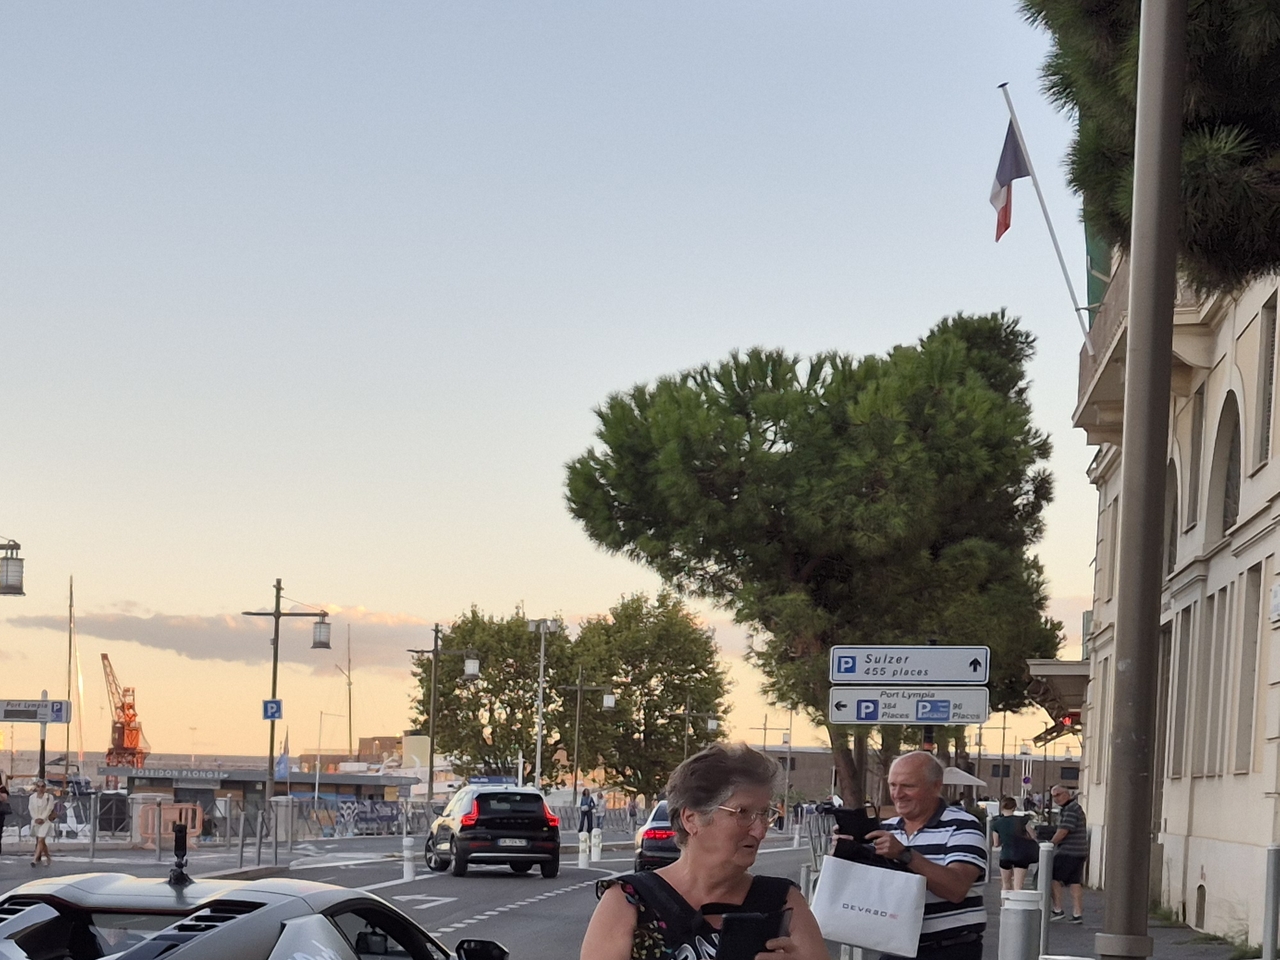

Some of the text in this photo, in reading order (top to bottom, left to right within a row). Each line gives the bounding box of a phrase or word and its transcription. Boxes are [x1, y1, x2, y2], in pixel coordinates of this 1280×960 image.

[865, 653, 910, 664] Sulzer
[840, 657, 853, 672] P
[863, 667, 929, 677] 455 places
[880, 690, 936, 700] Port Lympia
[24, 701, 48, 709] Lympia
[267, 703, 277, 716] P
[860, 702, 874, 718] P
[881, 711, 910, 719] Places
[952, 711, 981, 720] Places
[132, 769, 179, 777] POSEIDON
